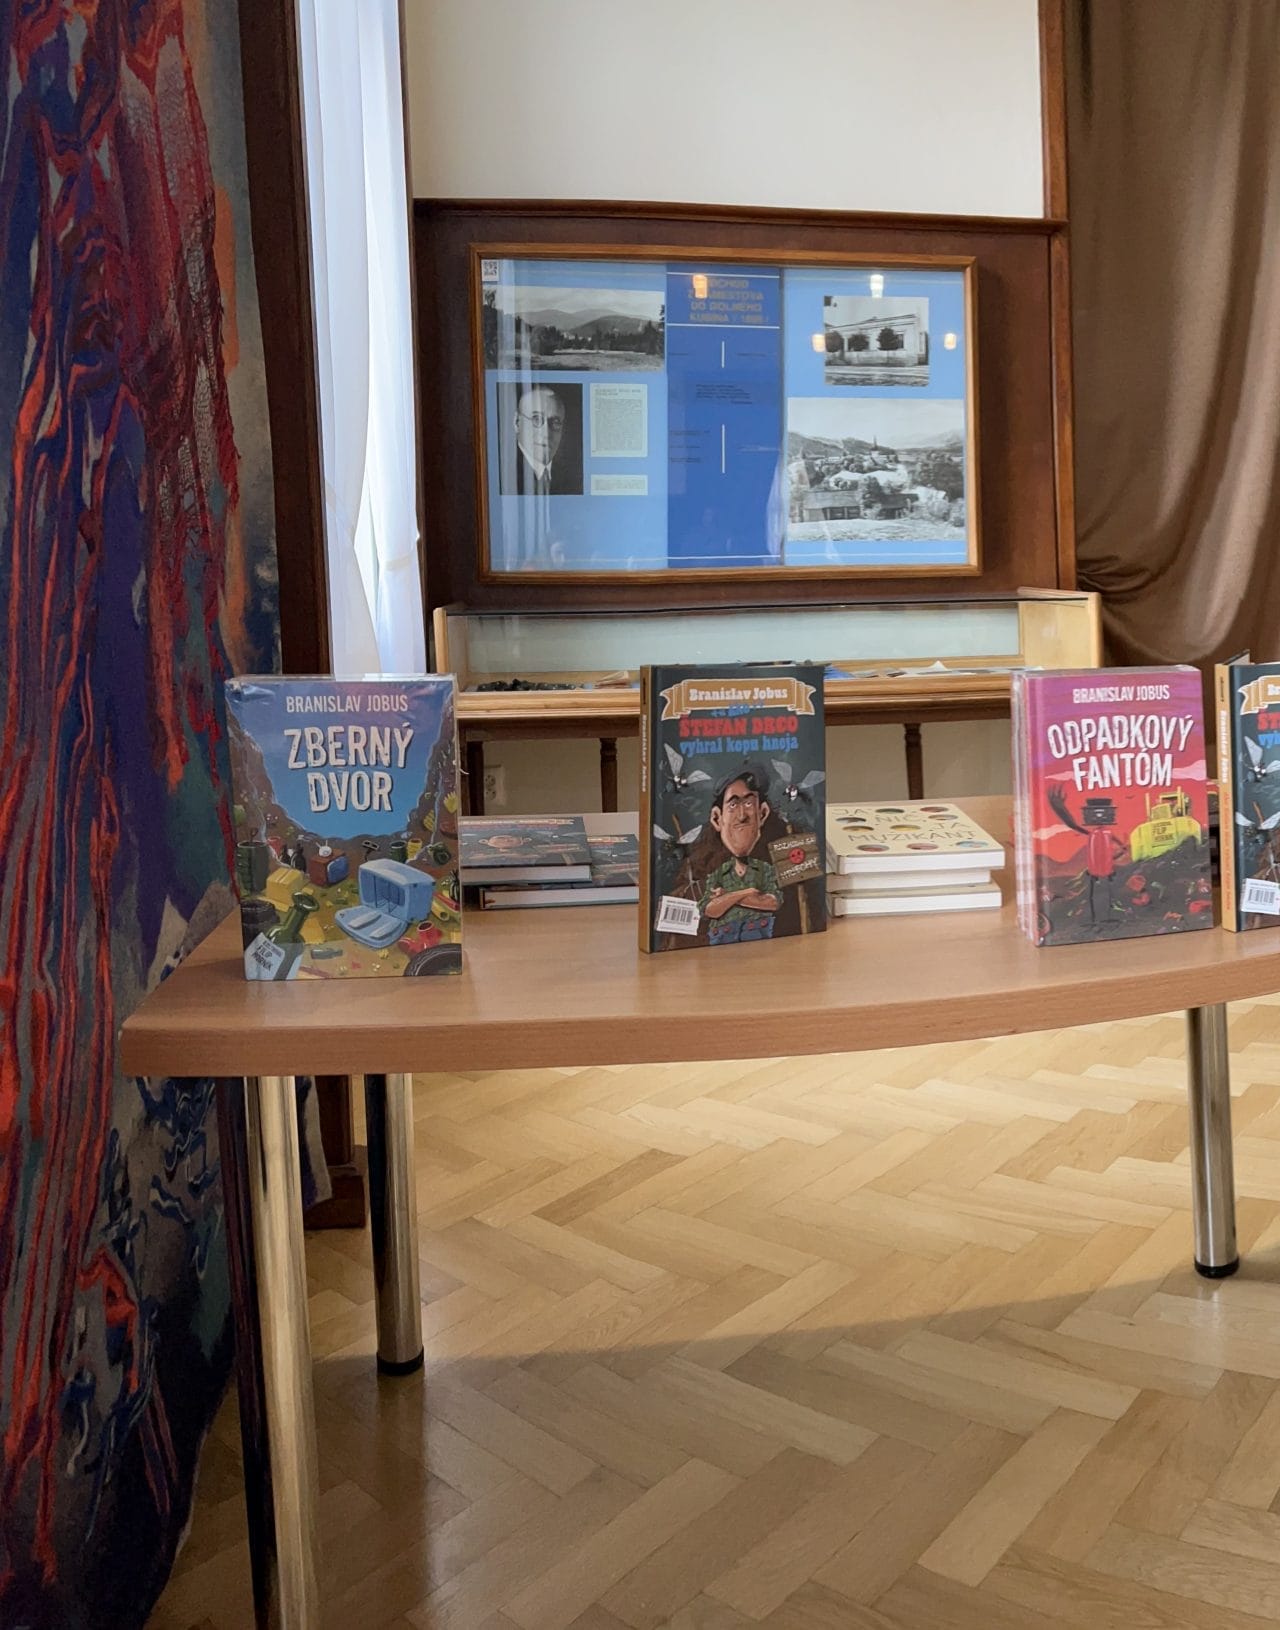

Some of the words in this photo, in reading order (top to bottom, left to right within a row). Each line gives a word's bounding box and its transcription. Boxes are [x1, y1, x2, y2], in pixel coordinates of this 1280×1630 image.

[286, 695, 361, 713] BRANISLAV
[366, 694, 408, 712] JOBUS
[689, 687, 752, 700] Branislav
[752, 687, 788, 700] Jobus
[1072, 686, 1133, 703] BRANISLAV
[1135, 685, 1170, 701] JOBUS
[679, 713, 748, 737] ŠTEFAN
[1047, 715, 1194, 759] ODPADKOVÝ
[284, 721, 414, 769] ZBERNÝ
[680, 737, 723, 758] vyhral
[726, 737, 759, 755] kopu
[1072, 747, 1173, 792] FANTÓM
[307, 770, 393, 812] DVOR
